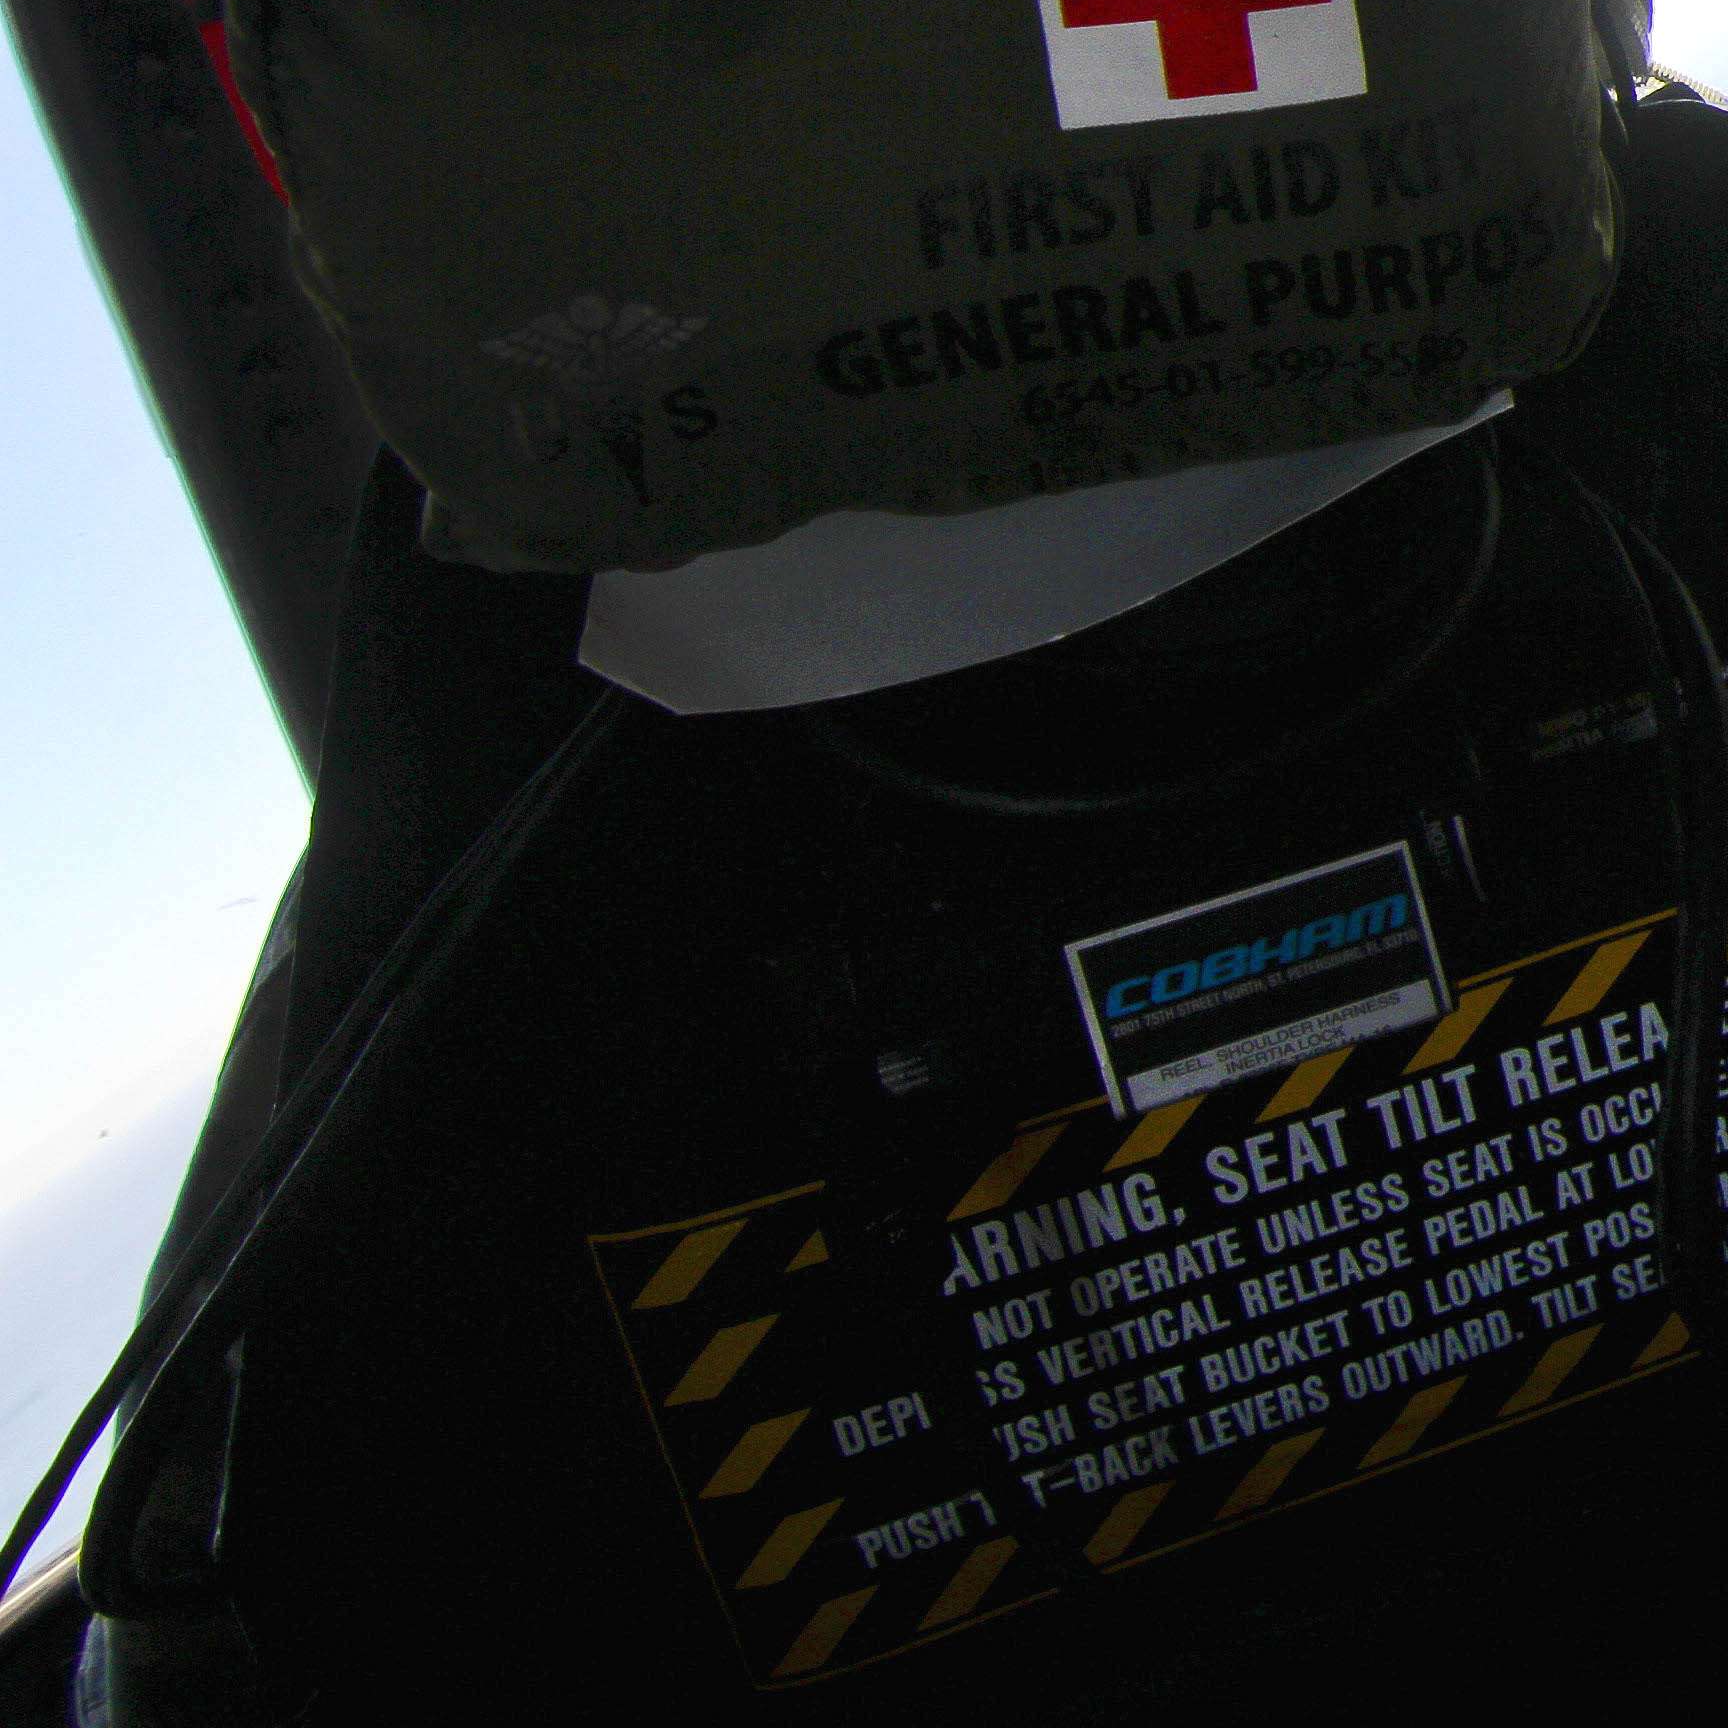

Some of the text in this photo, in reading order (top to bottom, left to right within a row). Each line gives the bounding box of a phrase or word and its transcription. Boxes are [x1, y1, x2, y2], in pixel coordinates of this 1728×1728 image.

[912, 104, 1484, 269] FIRST AID KIT
[812, 200, 1556, 399] GENERAL PURPOS
[1103, 891, 1410, 1019] COBHAM
[1177, 995, 1221, 1023] STREET
[1216, 1023, 1315, 1064] SHOULDER
[1315, 991, 1402, 1033] HARNESS
[1226, 1026, 1345, 1075] INERTIA LOCK
[943, 1169, 1188, 1296] ARNING,
[1203, 1108, 1350, 1206] SEAT
[1367, 1064, 1478, 1153] TILT
[972, 1288, 1055, 1351] NOT
[1069, 1226, 1247, 1318] OPERATE
[1256, 1170, 1410, 1257] UNLESS
[1422, 1133, 1513, 1200] SEAT
[1527, 1115, 1569, 1161] IS
[1037, 1295, 1232, 1391] VERTICAL
[1239, 1233, 1415, 1322] RELEASE
[1422, 1185, 1544, 1260] PEDAL
[1556, 1162, 1597, 1210] AT
[853, 1500, 966, 1570] PUSH
[1188, 1374, 1331, 1455] LEVERS
[1340, 1308, 1526, 1402] OUTWARD.
[1531, 1274, 1600, 1332] TILT
[1087, 1364, 1186, 1431] SEAT
[1201, 1309, 1354, 1395] BUCKET
[1362, 1290, 1414, 1337] TO
[1424, 1234, 1571, 1316] LOWEST
